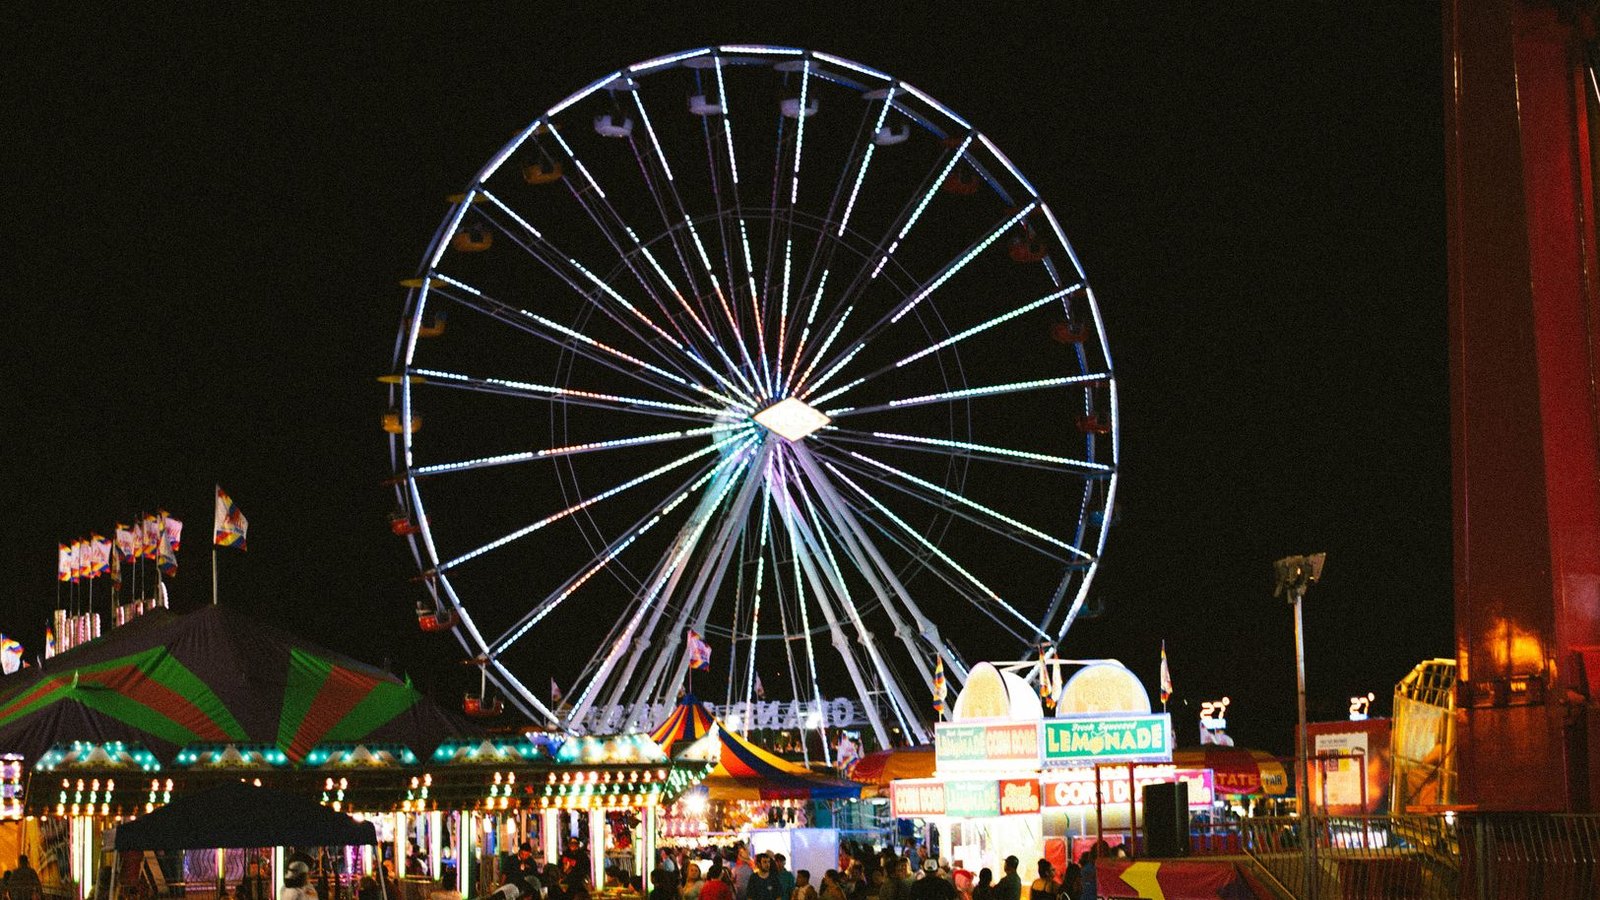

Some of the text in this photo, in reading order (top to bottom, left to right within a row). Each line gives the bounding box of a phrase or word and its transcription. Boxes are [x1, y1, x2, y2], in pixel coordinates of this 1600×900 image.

[1047, 723, 1163, 755] LEMONADE
[1214, 772, 1258, 786] TATE
[1054, 781, 1110, 806] CORN
